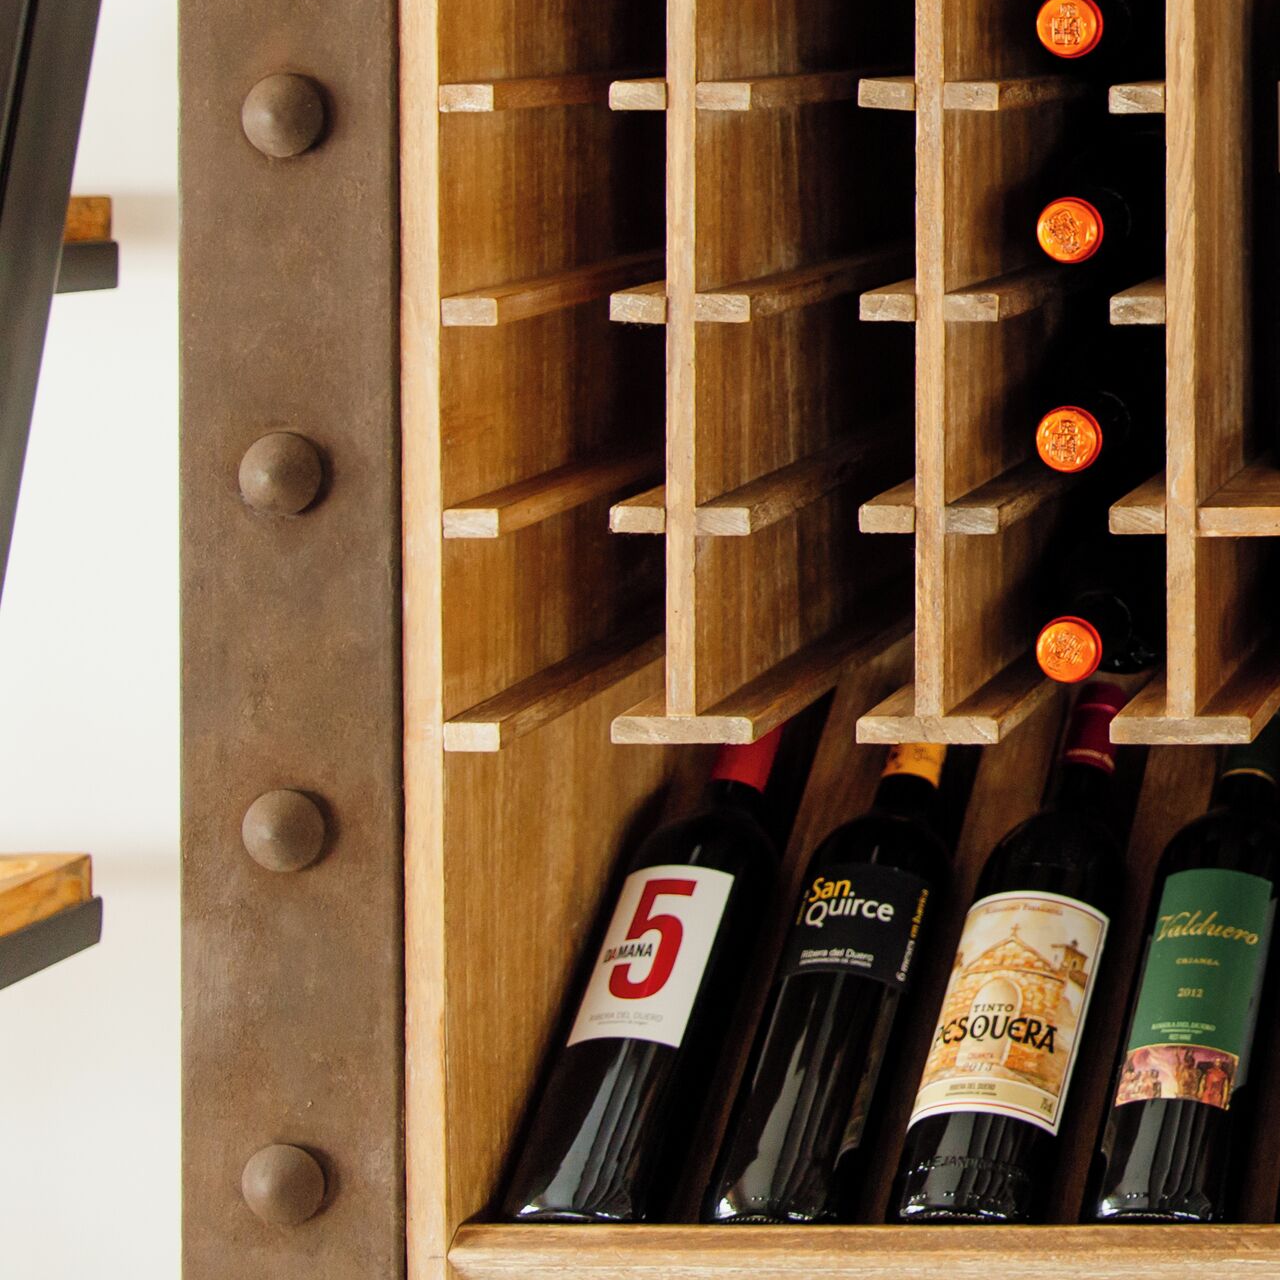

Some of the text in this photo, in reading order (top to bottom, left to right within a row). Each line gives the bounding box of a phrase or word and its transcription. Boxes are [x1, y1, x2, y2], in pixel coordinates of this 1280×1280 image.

[808, 876, 852, 903] San
[805, 890, 895, 928] Quirce
[608, 878, 698, 1000] 5
[1156, 909, 1259, 945] Valduero
[603, 942, 654, 964] DAMANA
[974, 1003, 1015, 1014] TINTO
